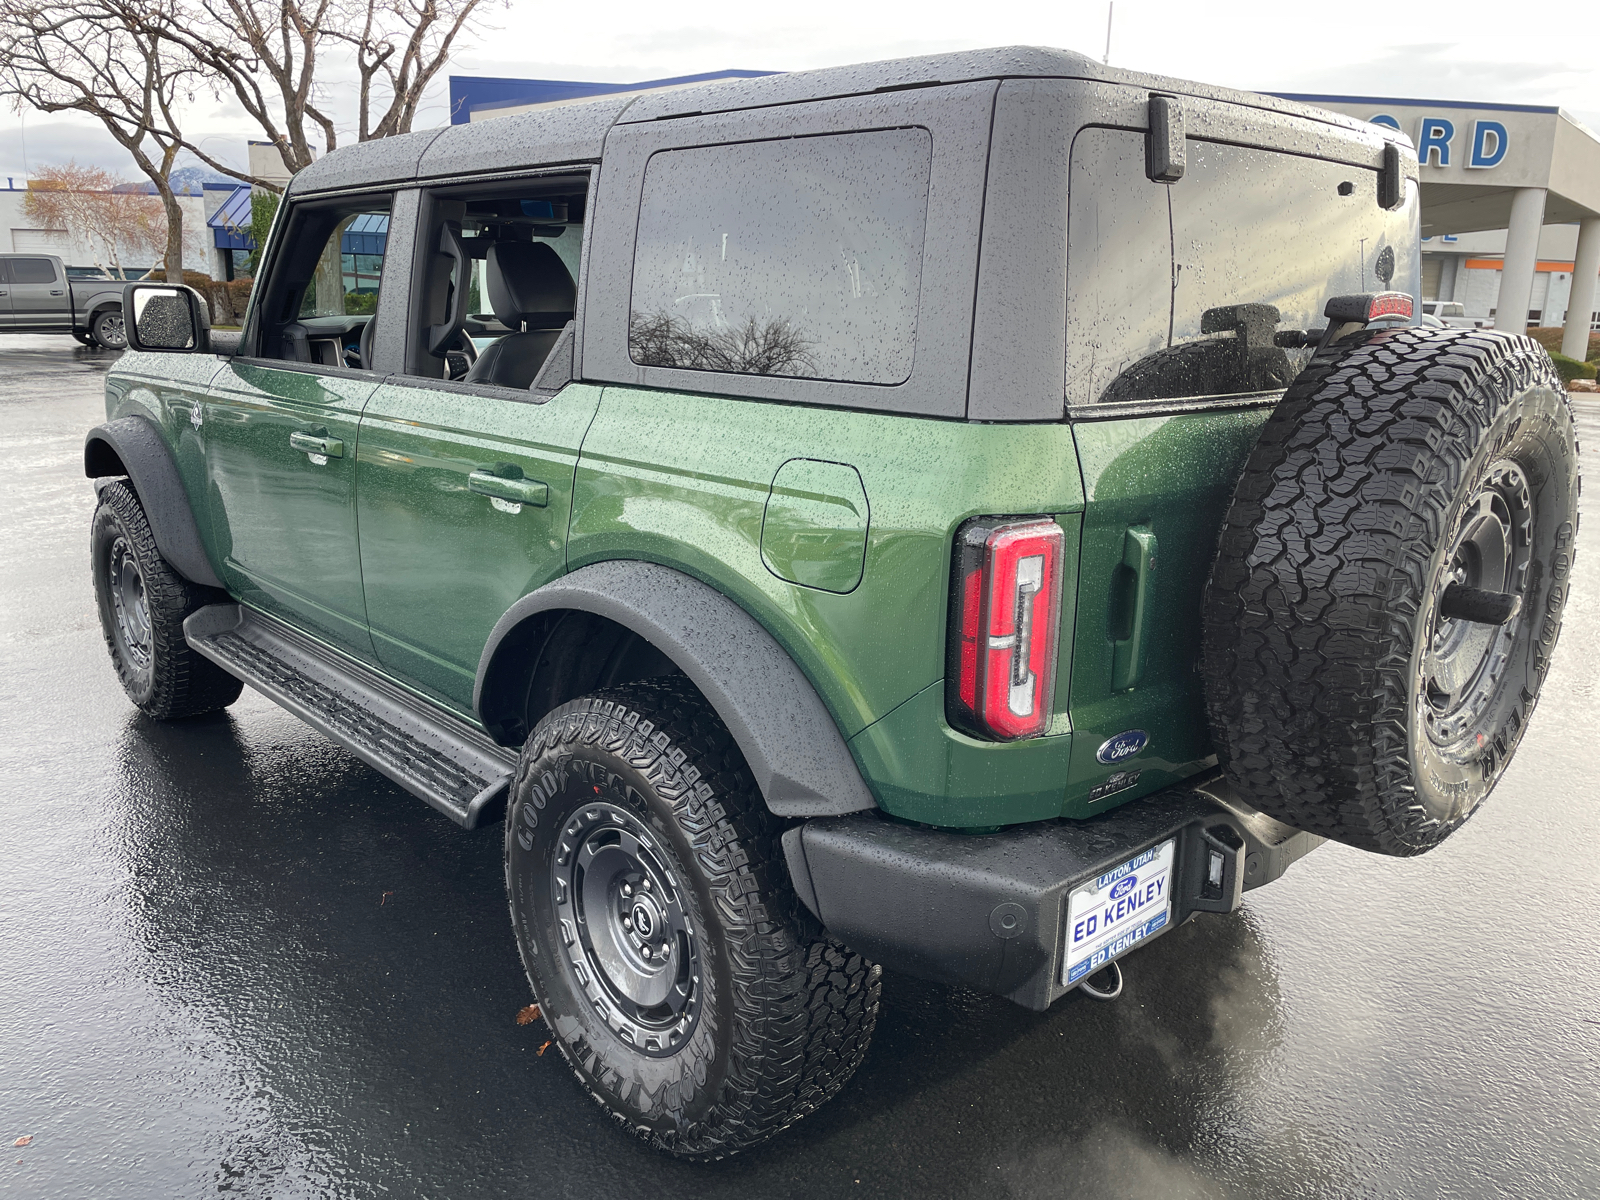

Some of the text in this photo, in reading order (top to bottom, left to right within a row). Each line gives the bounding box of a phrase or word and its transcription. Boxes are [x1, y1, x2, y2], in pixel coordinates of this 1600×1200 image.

[1111, 739, 1140, 759] Ford
[1098, 850, 1153, 888] LAYTON, UTAH
[1114, 877, 1134, 898] Ford
[1073, 914, 1097, 943] ED
[1104, 876, 1165, 928] KENLEY
[1090, 950, 1106, 969] ED
[1108, 922, 1149, 958] KENLEY
